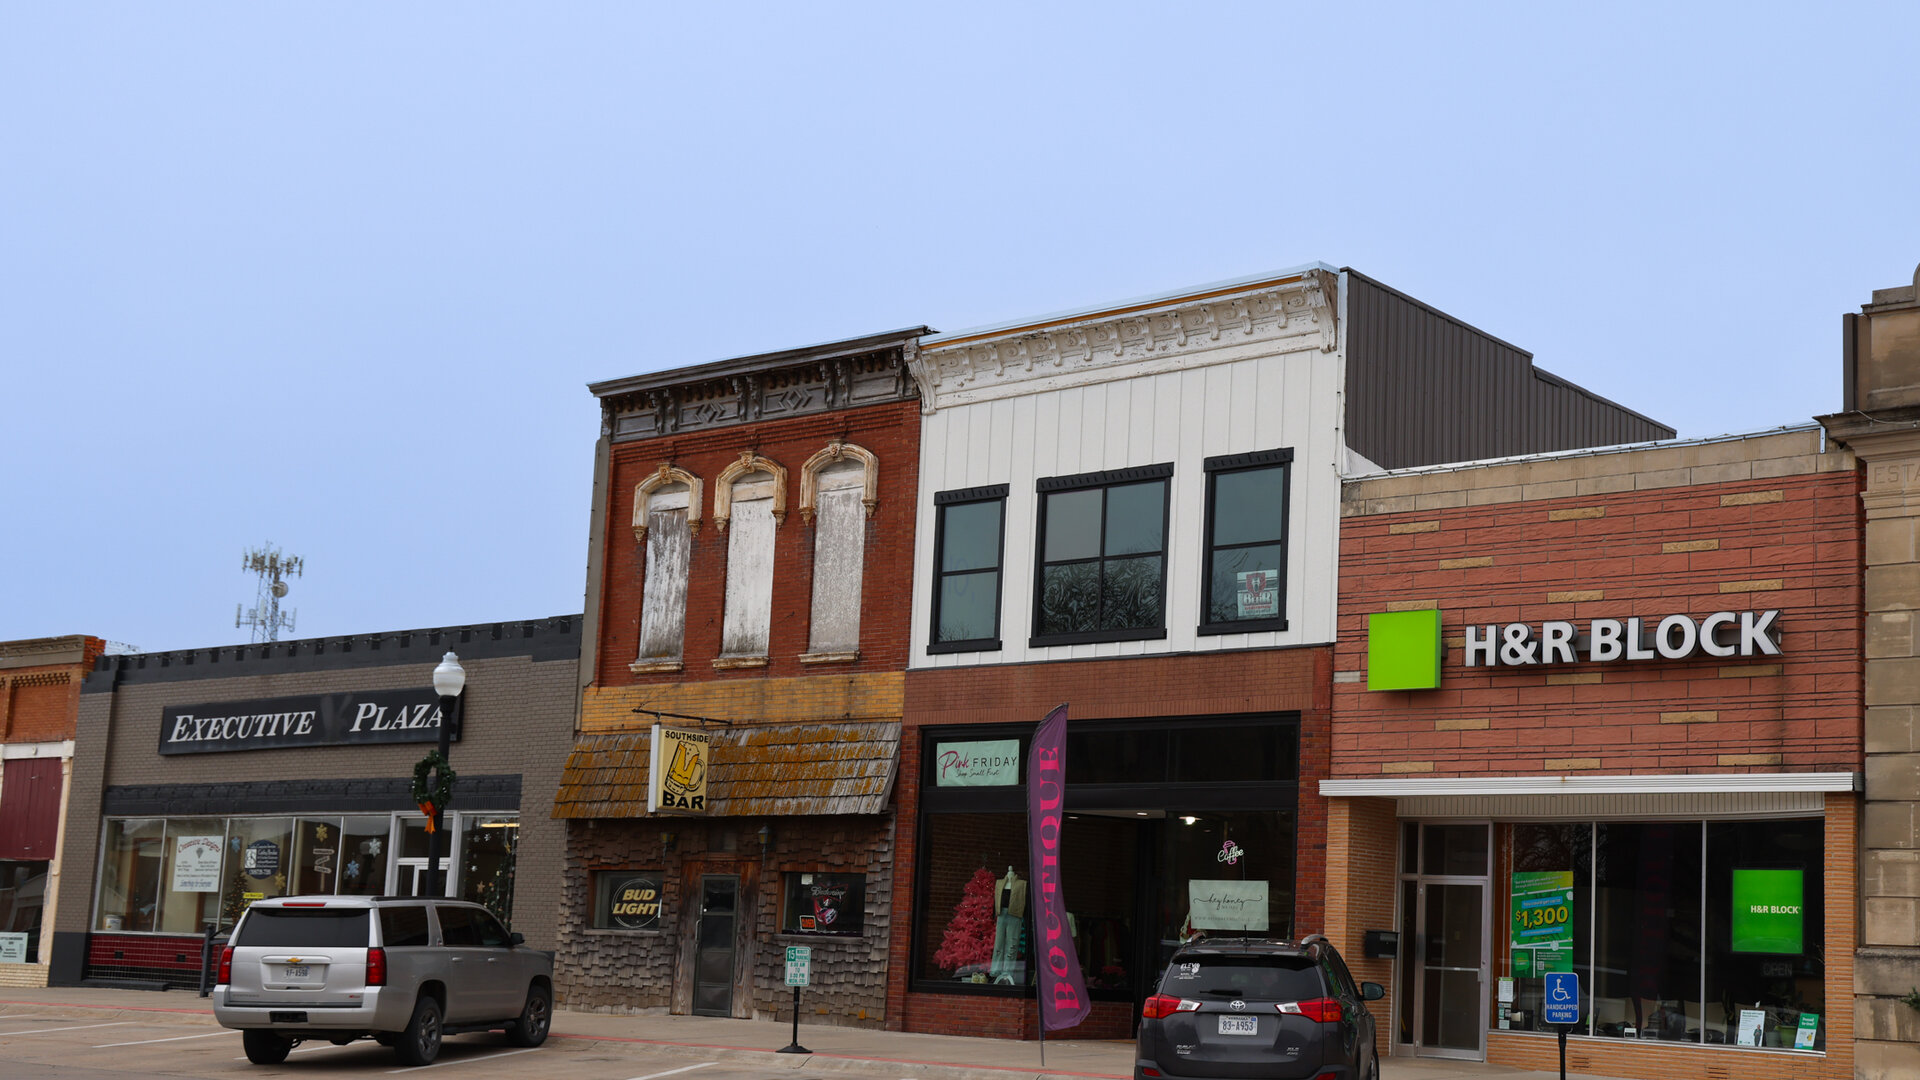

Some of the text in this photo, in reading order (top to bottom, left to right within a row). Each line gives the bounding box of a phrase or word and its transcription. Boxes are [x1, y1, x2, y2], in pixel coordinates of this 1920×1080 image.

[1465, 610, 1784, 667] H&R BLOCK
[167, 702, 442, 743] EXECUTIVE PLAZA
[665, 730, 709, 743] SOUTHSIDE
[938, 751, 1017, 779] Pink FRIDAY
[956, 769, 967, 777] Shop
[969, 768, 984, 777] Small
[662, 790, 704, 810] BAR
[1217, 845, 1244, 862] Coffee
[1039, 746, 1080, 1012] BOUTIQUE
[622, 889, 656, 901] BUD
[612, 903, 659, 915] LIGHT
[1750, 905, 1799, 914] H&R BLOCK
[1515, 906, 1569, 928] $1,300
[788, 950, 795, 960] 15
[1763, 962, 1793, 976] OPEN
[1222, 1021, 1254, 1032] 83-A953
